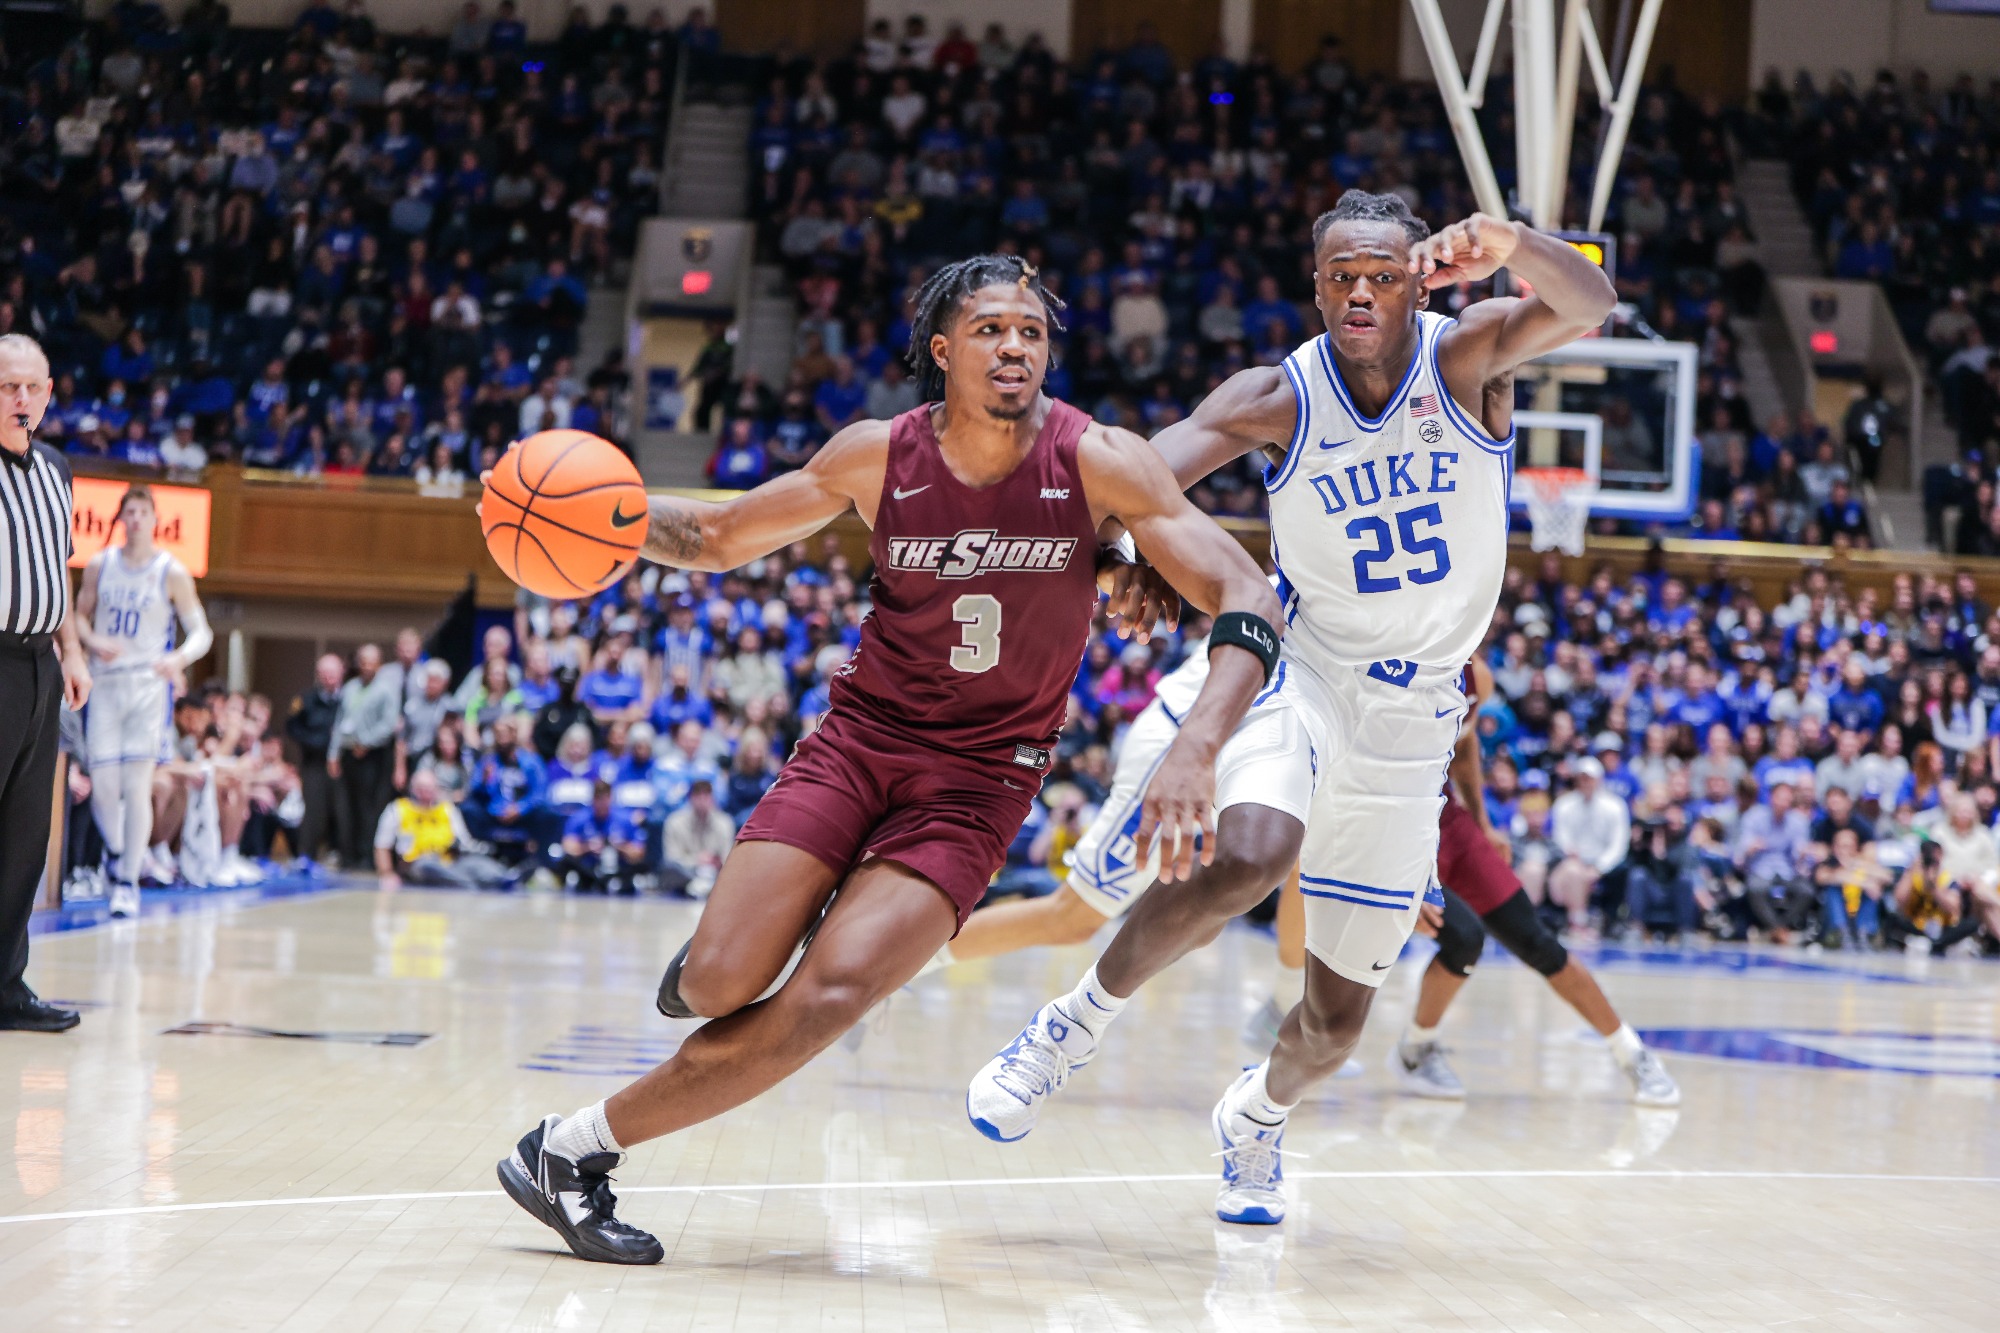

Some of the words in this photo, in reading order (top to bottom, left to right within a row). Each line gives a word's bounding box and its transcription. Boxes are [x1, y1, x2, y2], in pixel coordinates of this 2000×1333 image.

[1040, 487, 1070, 500] MEAC
[1308, 451, 1459, 515] DUKE
[889, 538, 948, 569] THE
[1345, 502, 1452, 594] 25
[108, 606, 140, 638] 30
[949, 593, 1002, 673] 3
[1241, 620, 1274, 654] LL10
